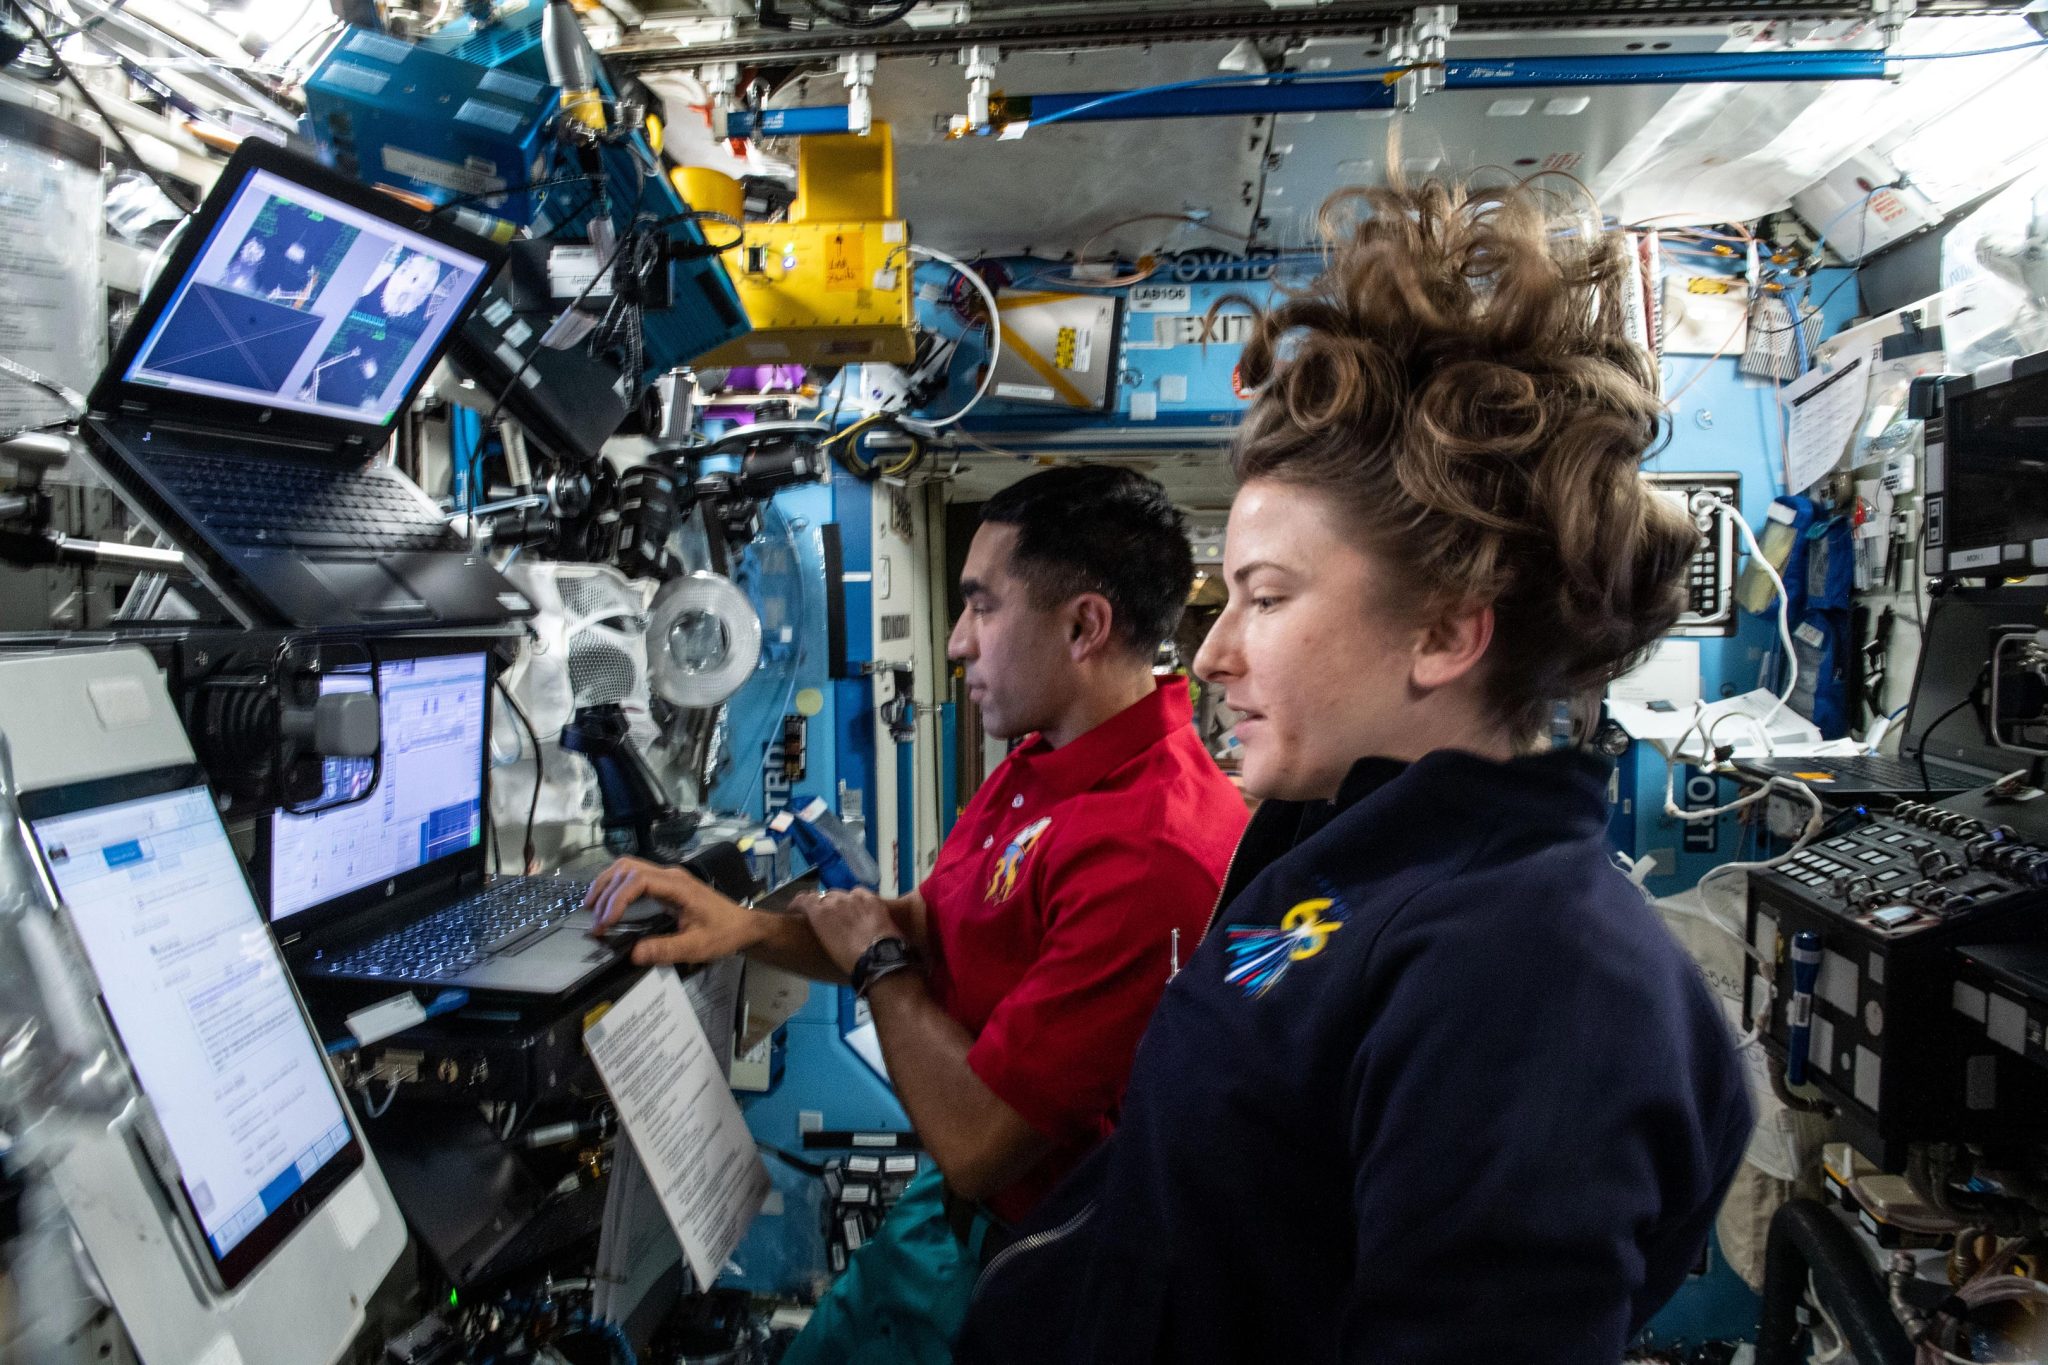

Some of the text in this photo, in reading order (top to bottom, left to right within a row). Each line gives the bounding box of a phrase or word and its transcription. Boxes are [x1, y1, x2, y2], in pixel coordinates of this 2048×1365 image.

[1175, 253, 1275, 282] OVHD
[1173, 316, 1252, 343] EXIT
[764, 743, 790, 822] TBD
[1687, 775, 1716, 849] ORT
